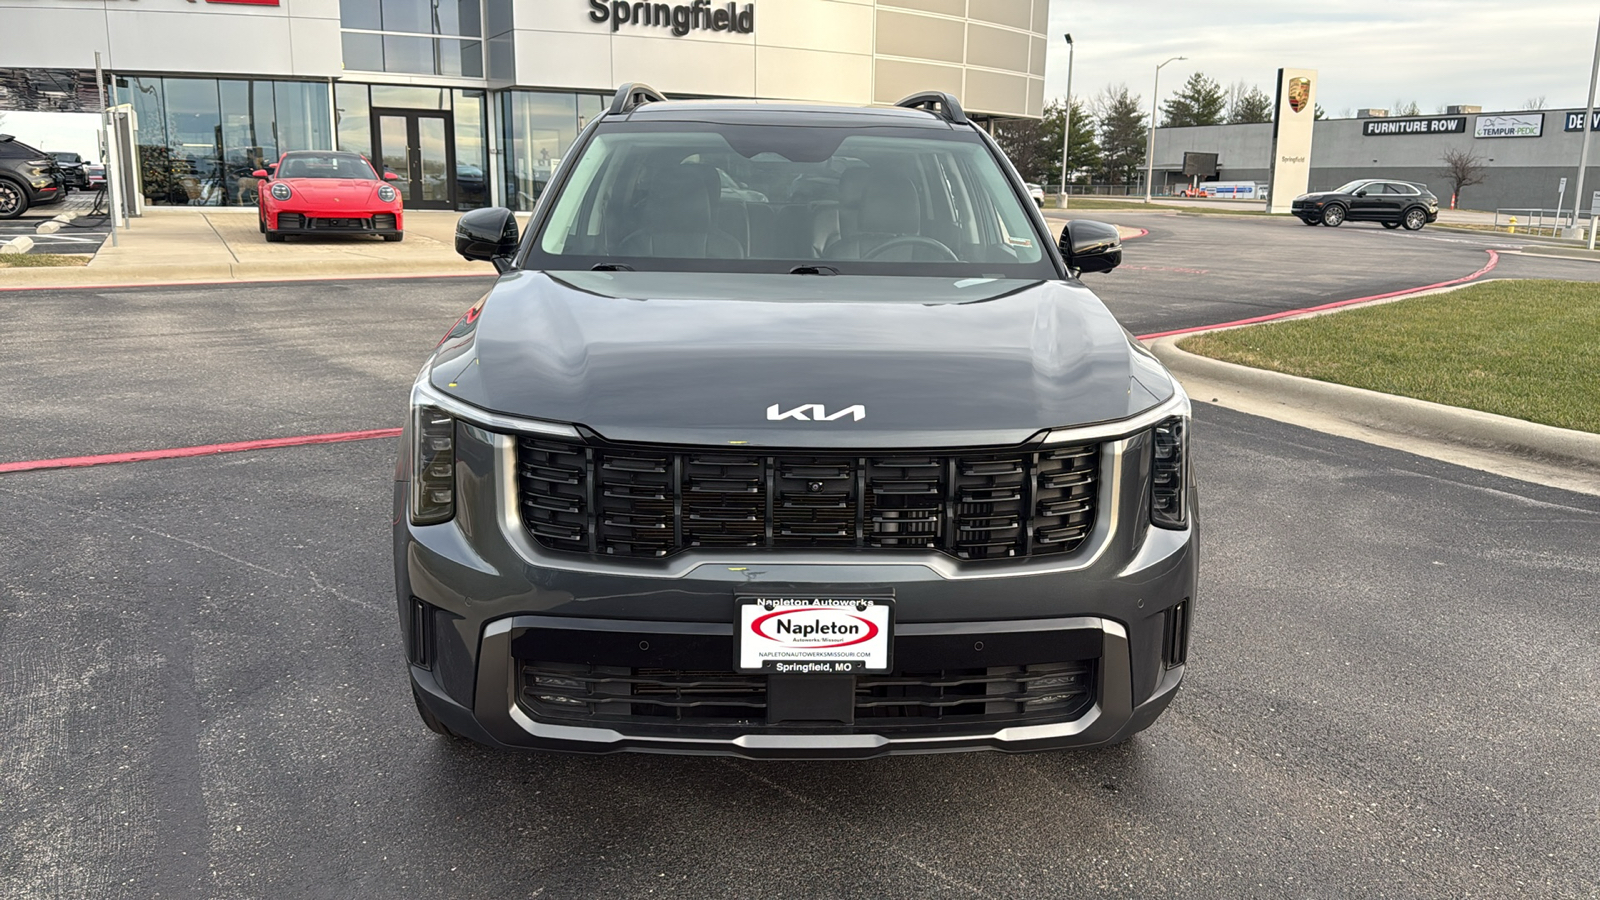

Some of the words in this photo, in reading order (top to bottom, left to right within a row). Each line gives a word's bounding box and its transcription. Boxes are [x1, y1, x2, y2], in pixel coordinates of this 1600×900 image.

[589, 0, 754, 36] Springfield
[1367, 121, 1428, 133] FURNITURE
[1430, 119, 1458, 131] ROW
[1568, 113, 1600, 129] DEV
[1482, 127, 1537, 136] TEMPUR-PEDIC
[1281, 156, 1305, 164] Springfield
[766, 403, 866, 422] KIA
[757, 598, 809, 608] Napleton
[812, 598, 874, 607] Autowerks
[776, 618, 859, 637] Napleton
[776, 662, 832, 673] Springfield,
[835, 662, 852, 672] MO
